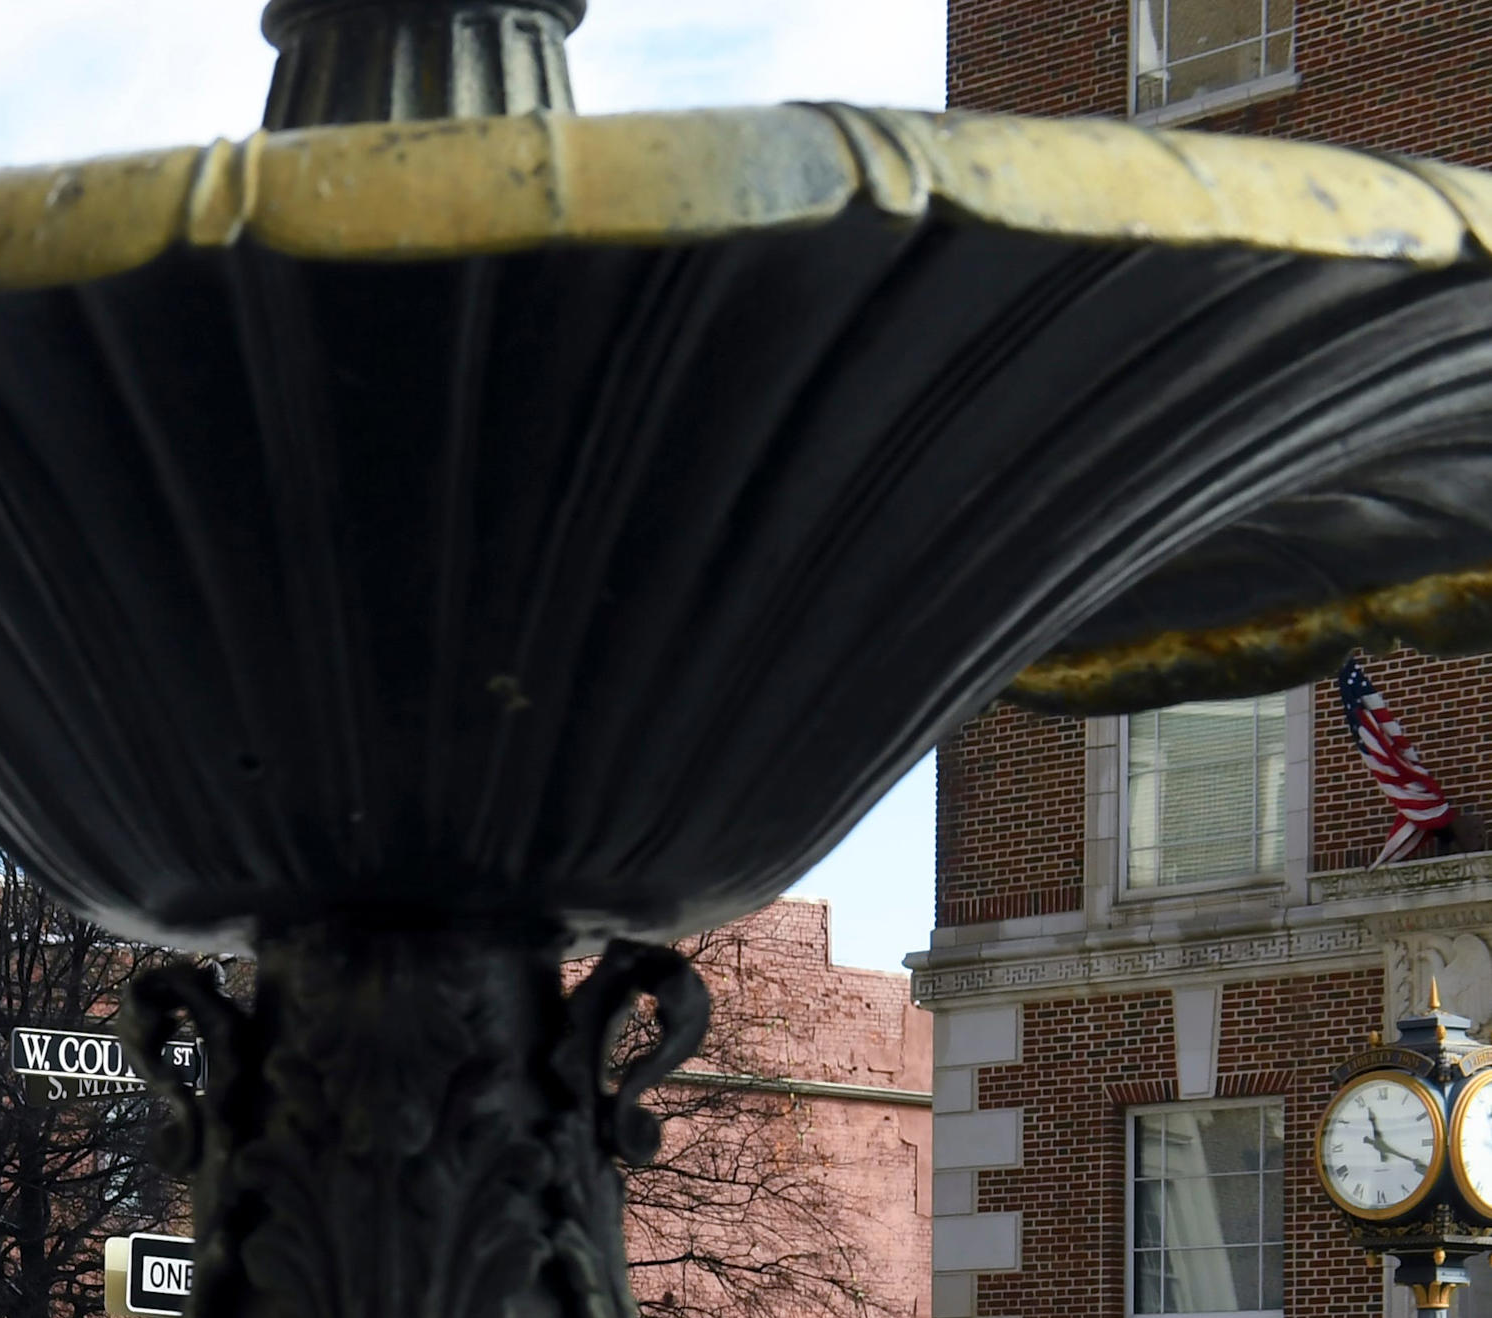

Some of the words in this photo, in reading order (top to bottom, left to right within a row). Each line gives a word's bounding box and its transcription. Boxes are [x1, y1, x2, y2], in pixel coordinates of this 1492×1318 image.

[19, 1033, 52, 1071] W.
[59, 1036, 142, 1077] COU
[173, 1047, 194, 1067] ST
